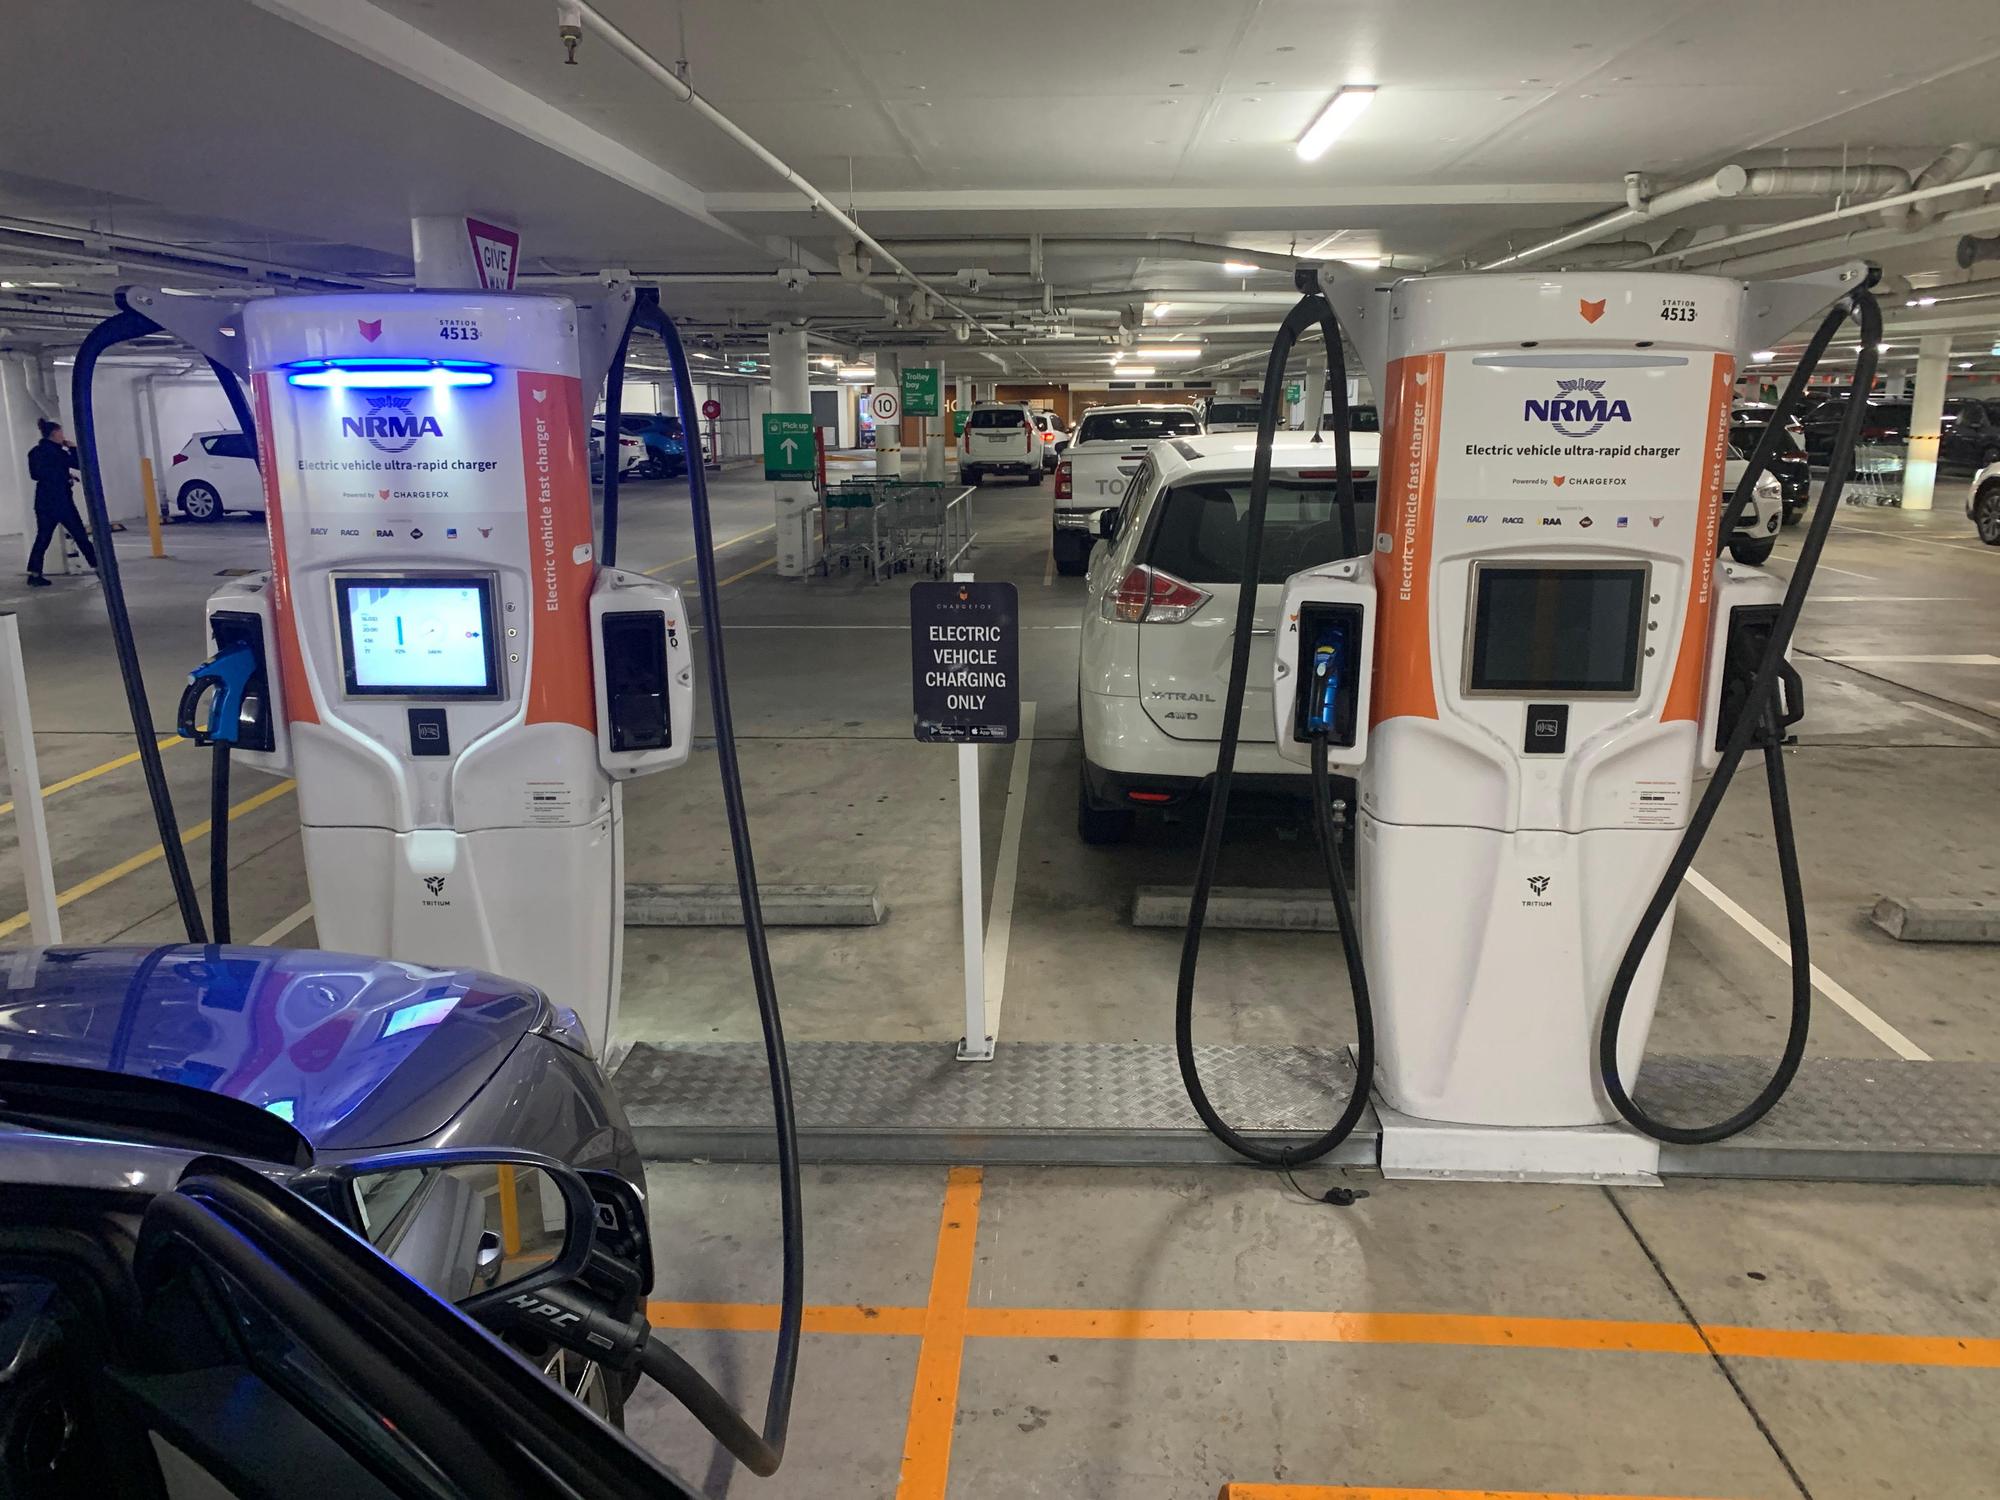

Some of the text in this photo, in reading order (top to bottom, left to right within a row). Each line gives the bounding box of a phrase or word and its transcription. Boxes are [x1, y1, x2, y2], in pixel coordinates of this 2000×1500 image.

[484, 246, 508, 272] GIVE
[489, 276, 505, 289] WAY
[1662, 299, 1695, 307] STATION
[1660, 308, 1696, 322] 4513
[440, 327, 479, 341] 4513
[906, 372, 929, 381] Trolley
[906, 382, 920, 390] bay
[878, 400, 892, 412] 10
[1524, 399, 1632, 422] NRMA
[342, 416, 443, 438] NRMA
[1466, 444, 1680, 458] Electric vehicle ultra-rapid charger
[298, 460, 498, 472] Electric vehicle ultra-rapid charger
[1095, 479, 1129, 496] TO
[1539, 478, 1548, 486] by
[1569, 478, 1626, 486] CHARGEFOX
[1400, 402, 1426, 601] Electric vehicle fast charger
[1699, 402, 1728, 604] Electric vehicle fast charger
[535, 418, 558, 611] Electric vehicle fast charger
[1466, 515, 1488, 524] RACV
[1502, 516, 1524, 524] RACQ
[1542, 518, 1562, 526] RAA
[930, 626, 1001, 642] ELECTRIC
[1290, 624, 1297, 632] A
[934, 650, 997, 665] VEHICLE
[926, 671, 1006, 688] CHARGING
[947, 694, 986, 710] ONLY
[1152, 692, 1216, 702] X-TRAIL
[1164, 712, 1198, 720] 4WD
[506, 1294, 580, 1328] HPC
